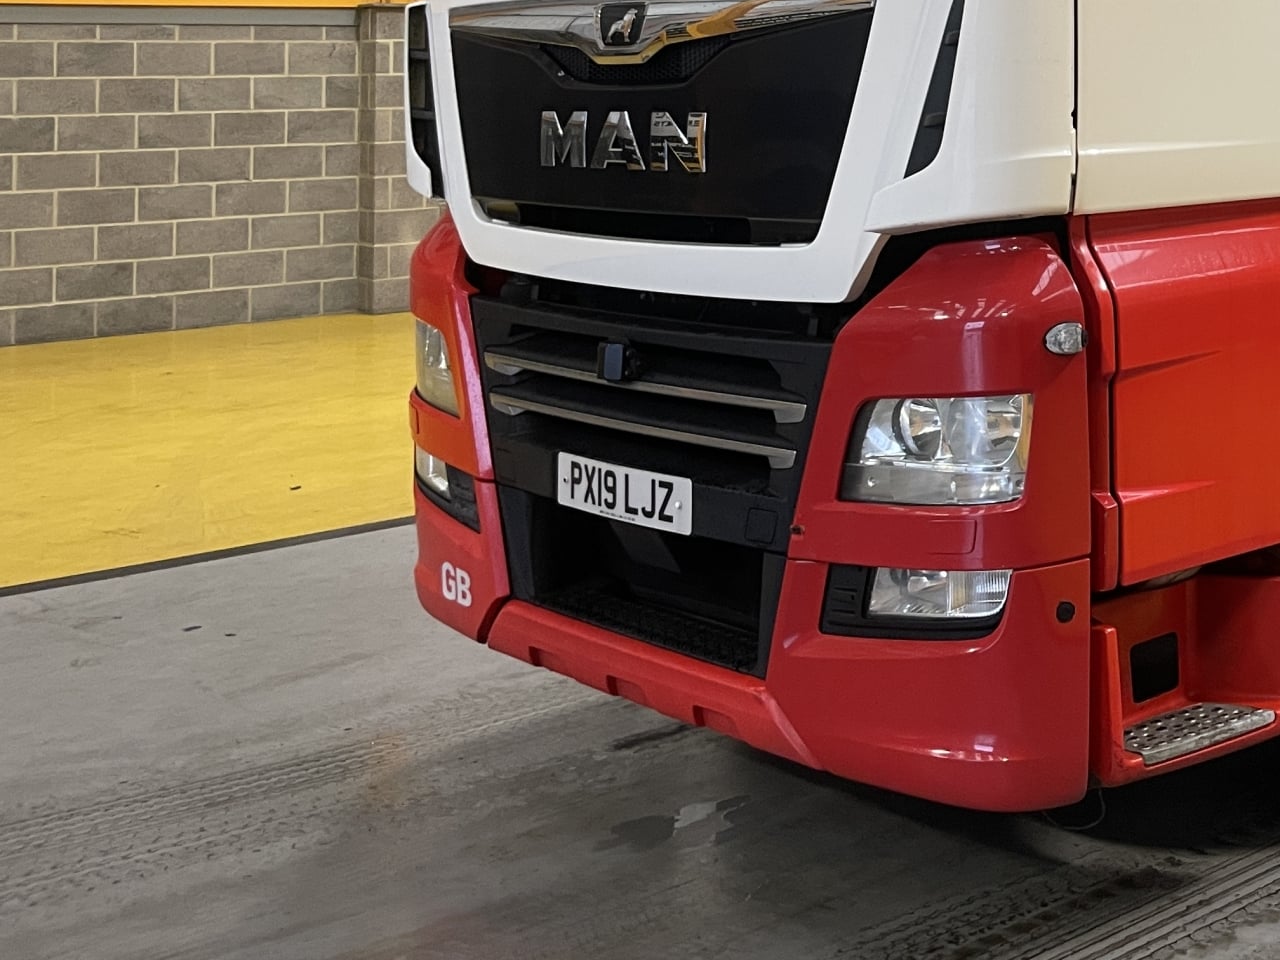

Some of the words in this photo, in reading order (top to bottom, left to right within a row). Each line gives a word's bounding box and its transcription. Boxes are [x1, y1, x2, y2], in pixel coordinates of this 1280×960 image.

[541, 111, 707, 172] MAN
[570, 460, 617, 510] PX19
[624, 473, 674, 523] LJZ
[441, 561, 472, 607] GB
